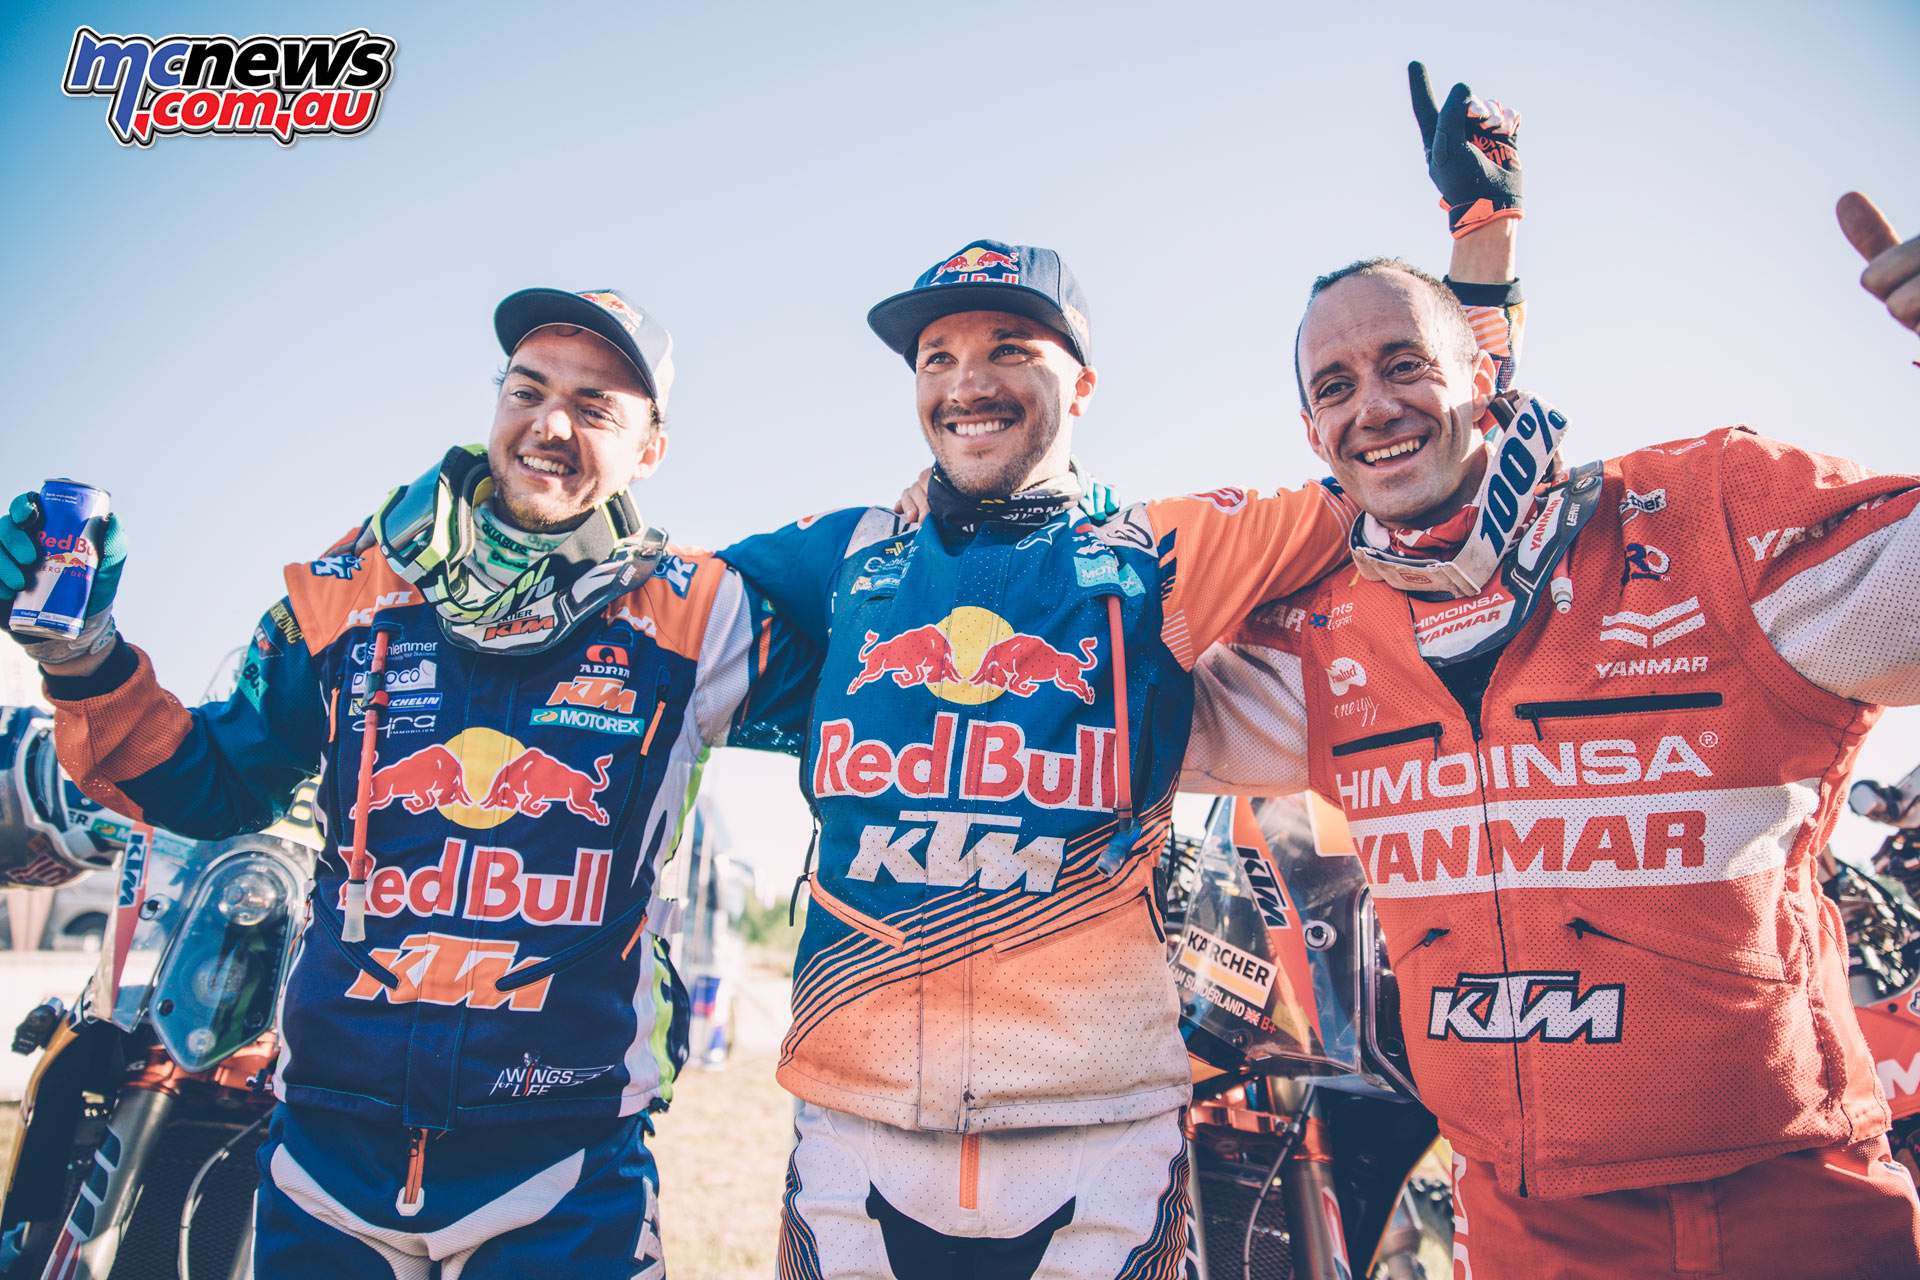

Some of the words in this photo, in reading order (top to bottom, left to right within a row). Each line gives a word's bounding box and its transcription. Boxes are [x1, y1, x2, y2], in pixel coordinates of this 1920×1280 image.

[1529, 498, 1562, 552] YANMAR
[482, 614, 555, 642] KTM
[1418, 609, 1501, 646] YANMAR
[545, 675, 638, 715] KTM
[1594, 655, 1709, 679] YANMAR
[559, 709, 641, 734] MOTOREX
[813, 711, 959, 799] Red
[960, 718, 1119, 813] Bull
[844, 810, 1067, 893] KTM
[1351, 809, 1707, 885] YANMAR
[462, 845, 614, 927] Bull
[1234, 845, 1301, 929] KTM
[344, 932, 556, 1013] KTM
[1426, 970, 1627, 1045] KTM
